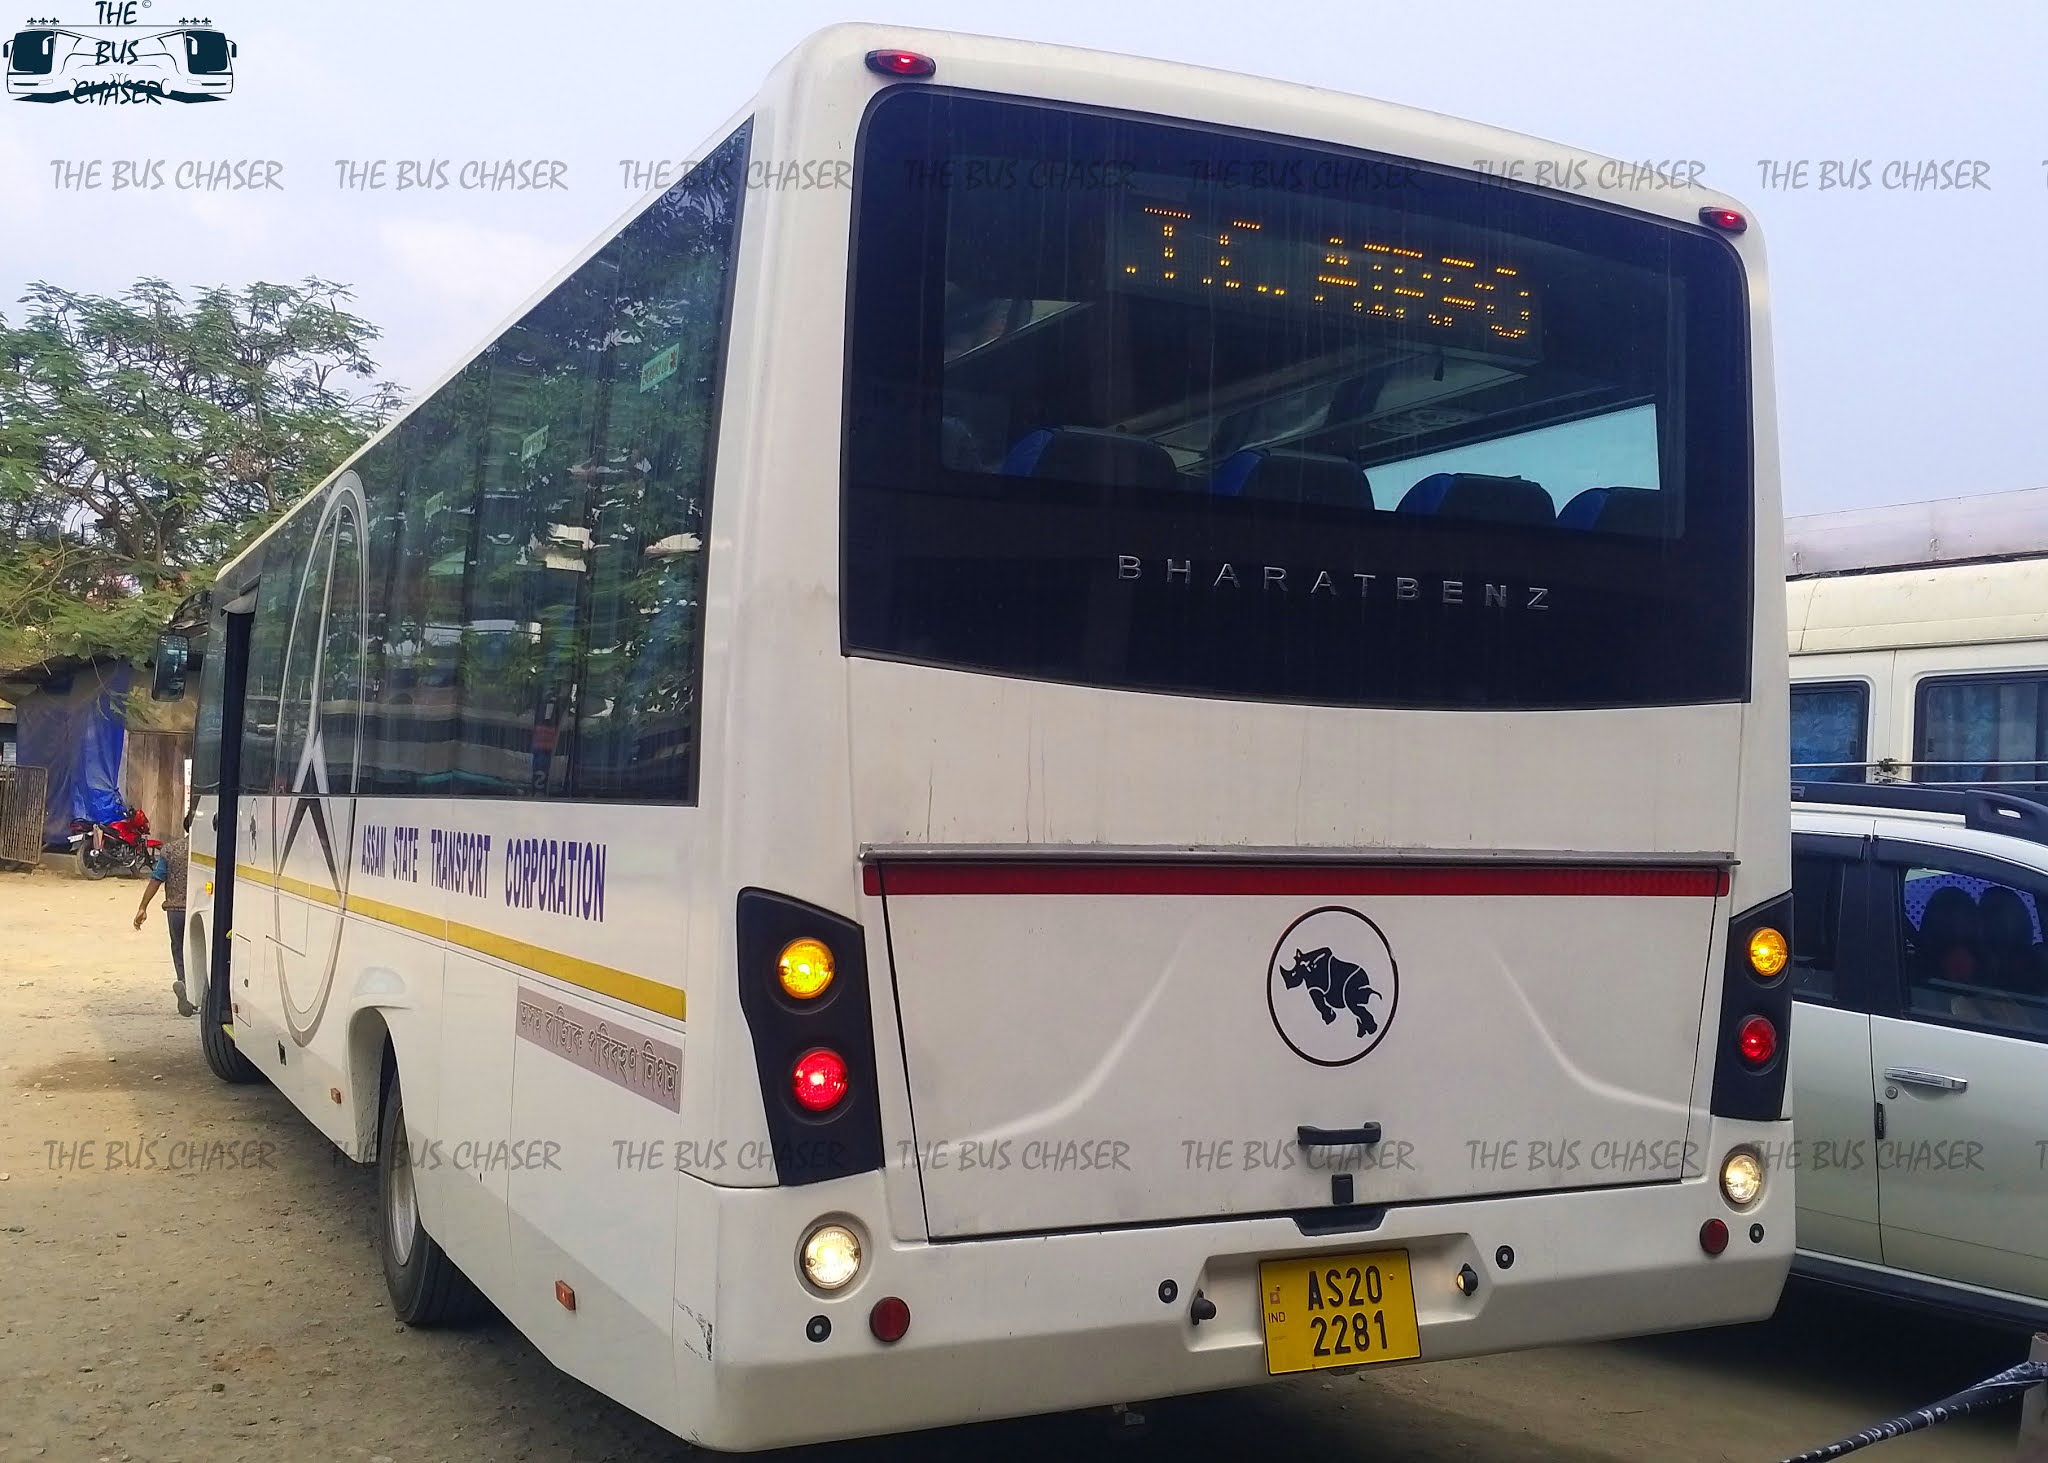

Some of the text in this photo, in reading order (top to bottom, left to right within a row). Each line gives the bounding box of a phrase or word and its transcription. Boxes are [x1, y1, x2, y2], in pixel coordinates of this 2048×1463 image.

[1117, 554, 1550, 610] BHARATBENZ
[361, 824, 607, 923] ASSAM STATE TRANSPORT CORPORATION
[1308, 1265, 1383, 1311] AS20
[1268, 1311, 1286, 1324] IND
[1310, 1310, 1388, 1357] 2281
